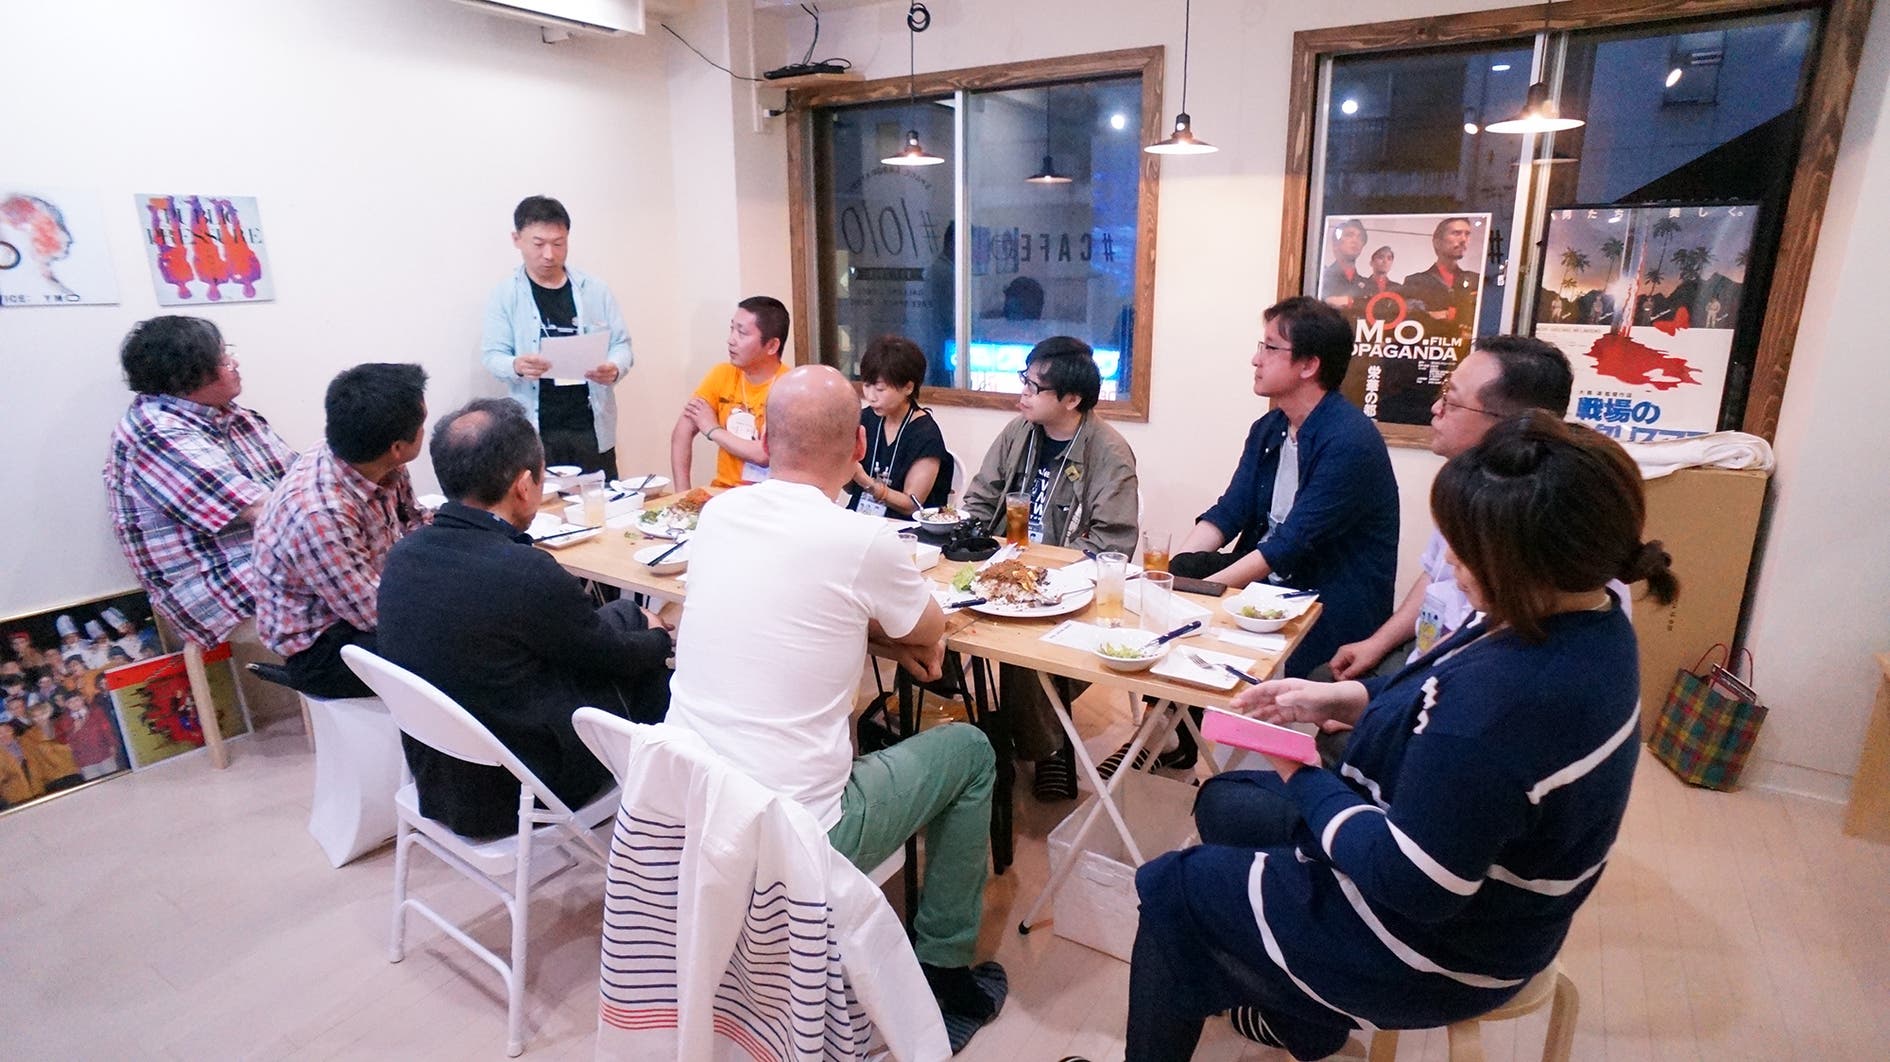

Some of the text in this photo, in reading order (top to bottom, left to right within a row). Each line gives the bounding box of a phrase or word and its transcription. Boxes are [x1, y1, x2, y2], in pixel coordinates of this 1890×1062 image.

[1430, 337, 1462, 347] FILM
[1576, 397, 1661, 425] 戦場の
